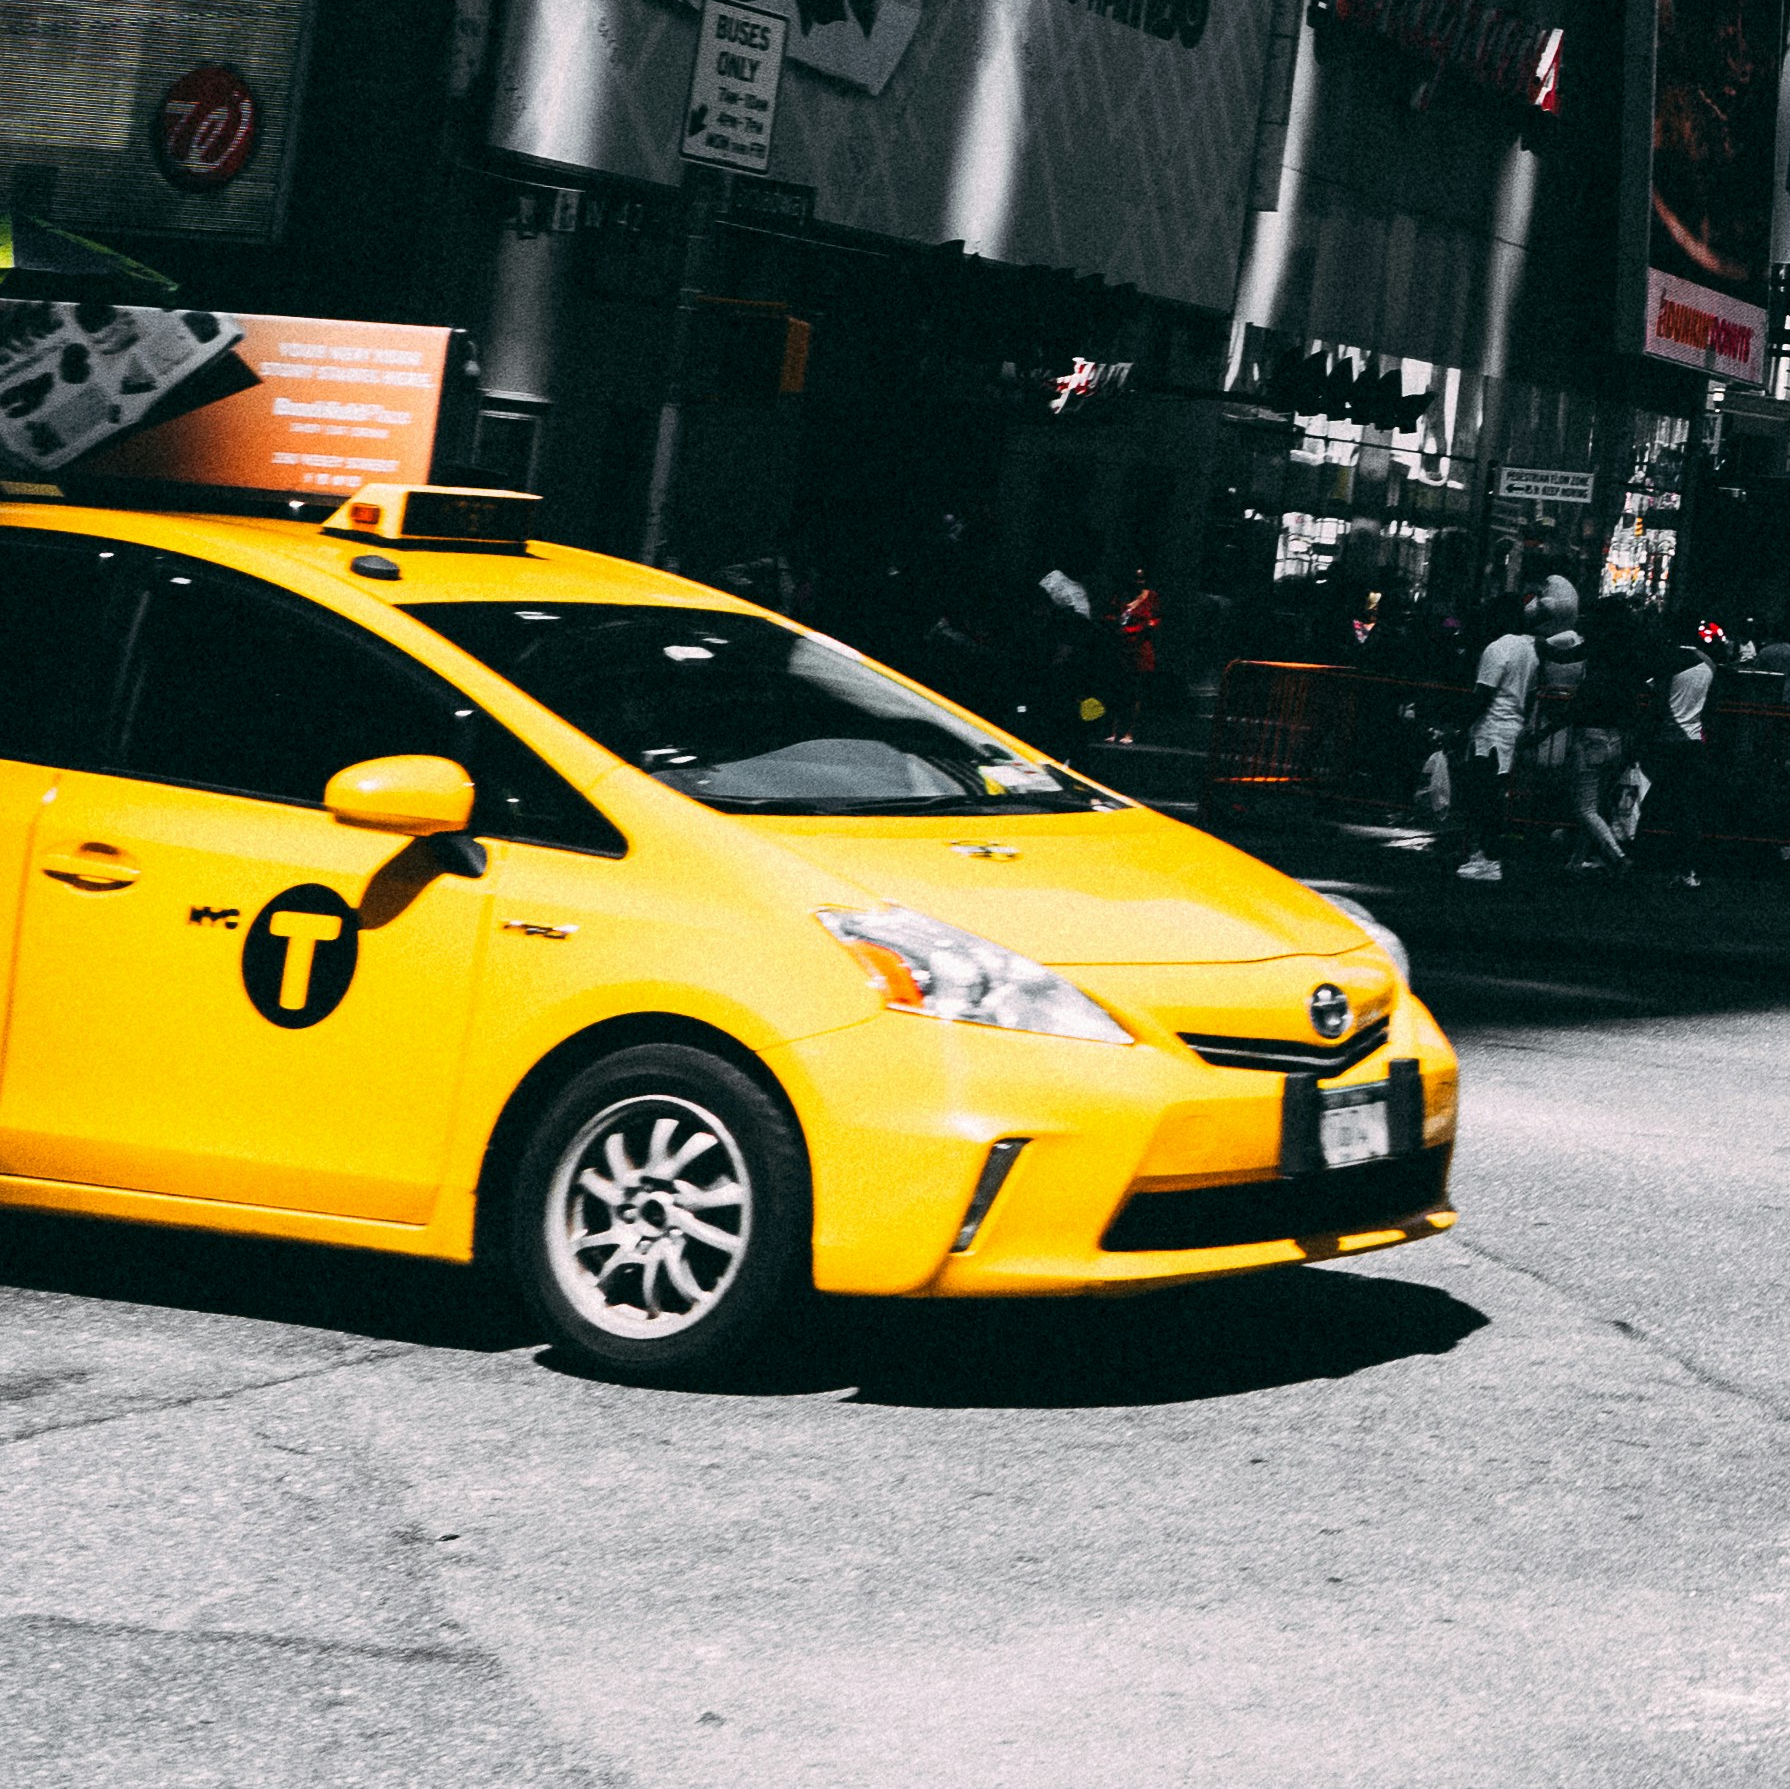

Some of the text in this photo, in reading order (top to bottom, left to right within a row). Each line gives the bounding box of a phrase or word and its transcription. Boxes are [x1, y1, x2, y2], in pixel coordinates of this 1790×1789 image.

[716, 14, 770, 51] BUSES
[717, 51, 761, 83] ONLY
[270, 912, 343, 1010] T
